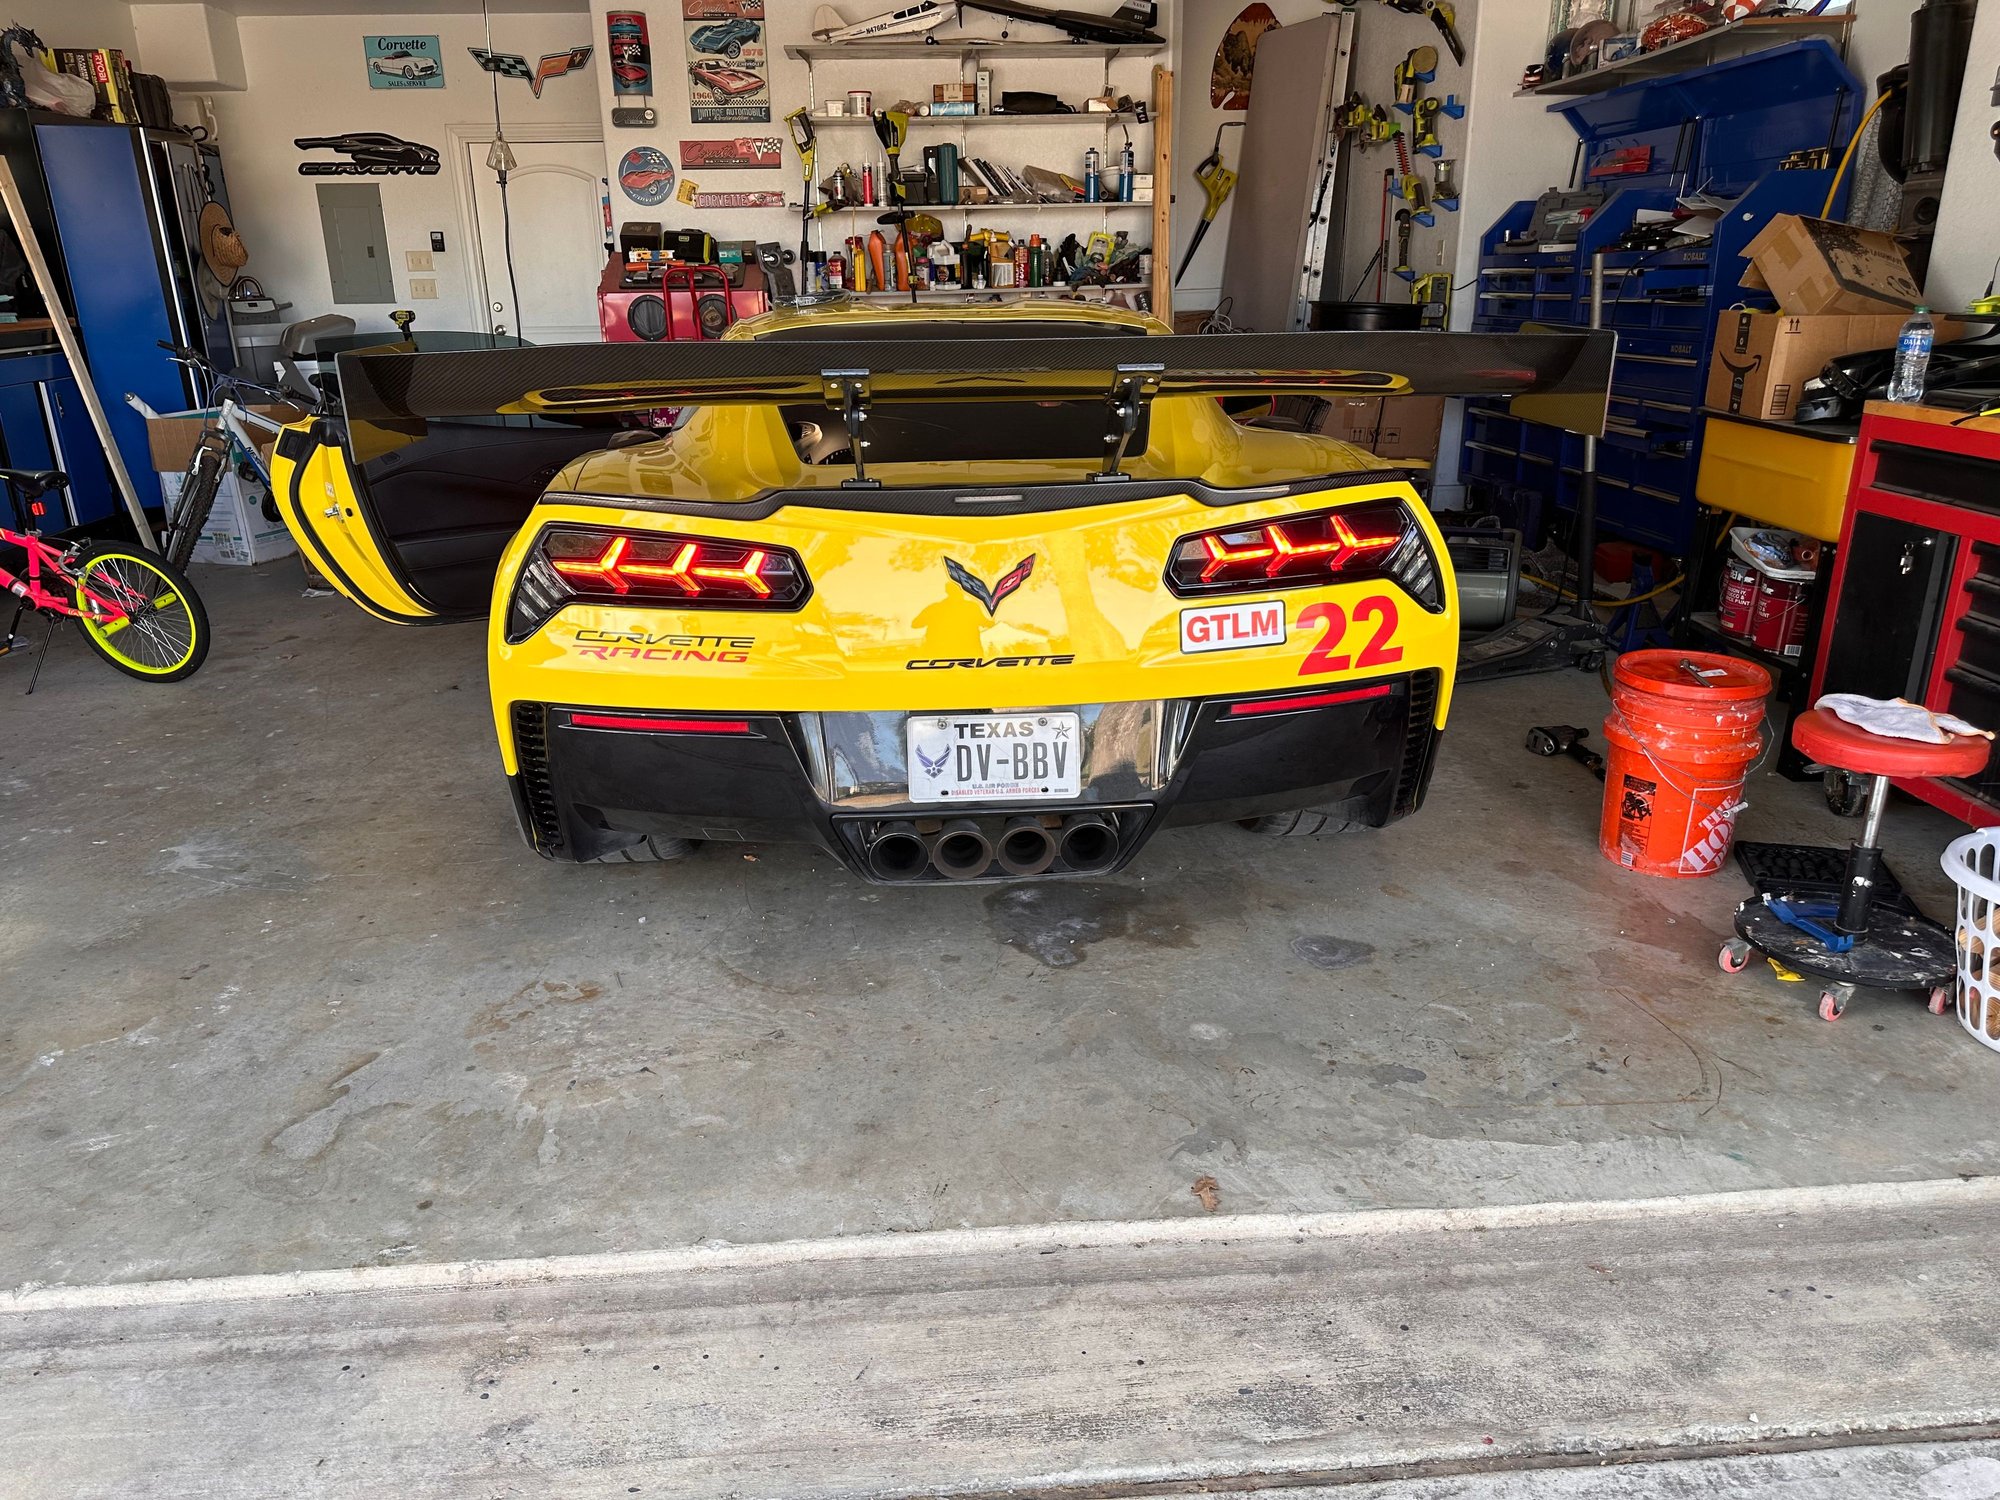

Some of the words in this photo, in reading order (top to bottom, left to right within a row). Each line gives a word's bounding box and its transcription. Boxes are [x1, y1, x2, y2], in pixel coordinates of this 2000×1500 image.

[377, 37, 427, 51] Corvette
[95, 54, 108, 82] RYOBI
[692, 92, 713, 100] 1966
[697, 108, 725, 120] VINTAGE
[726, 108, 767, 119] AUTOMOBILE
[300, 163, 440, 174] CORVETTE
[699, 194, 748, 207] CORVETTE
[1670, 345, 1693, 354] KOBALT
[1186, 609, 1278, 643] GTLM
[575, 629, 755, 648] CORVETTE
[1296, 596, 1403, 676] 22
[572, 644, 750, 663] RACING
[906, 654, 1075, 670] CORVETTE
[953, 721, 1034, 739] TEXAS
[956, 741, 1068, 782] DV-BBV
[1684, 818, 1734, 872] HO
